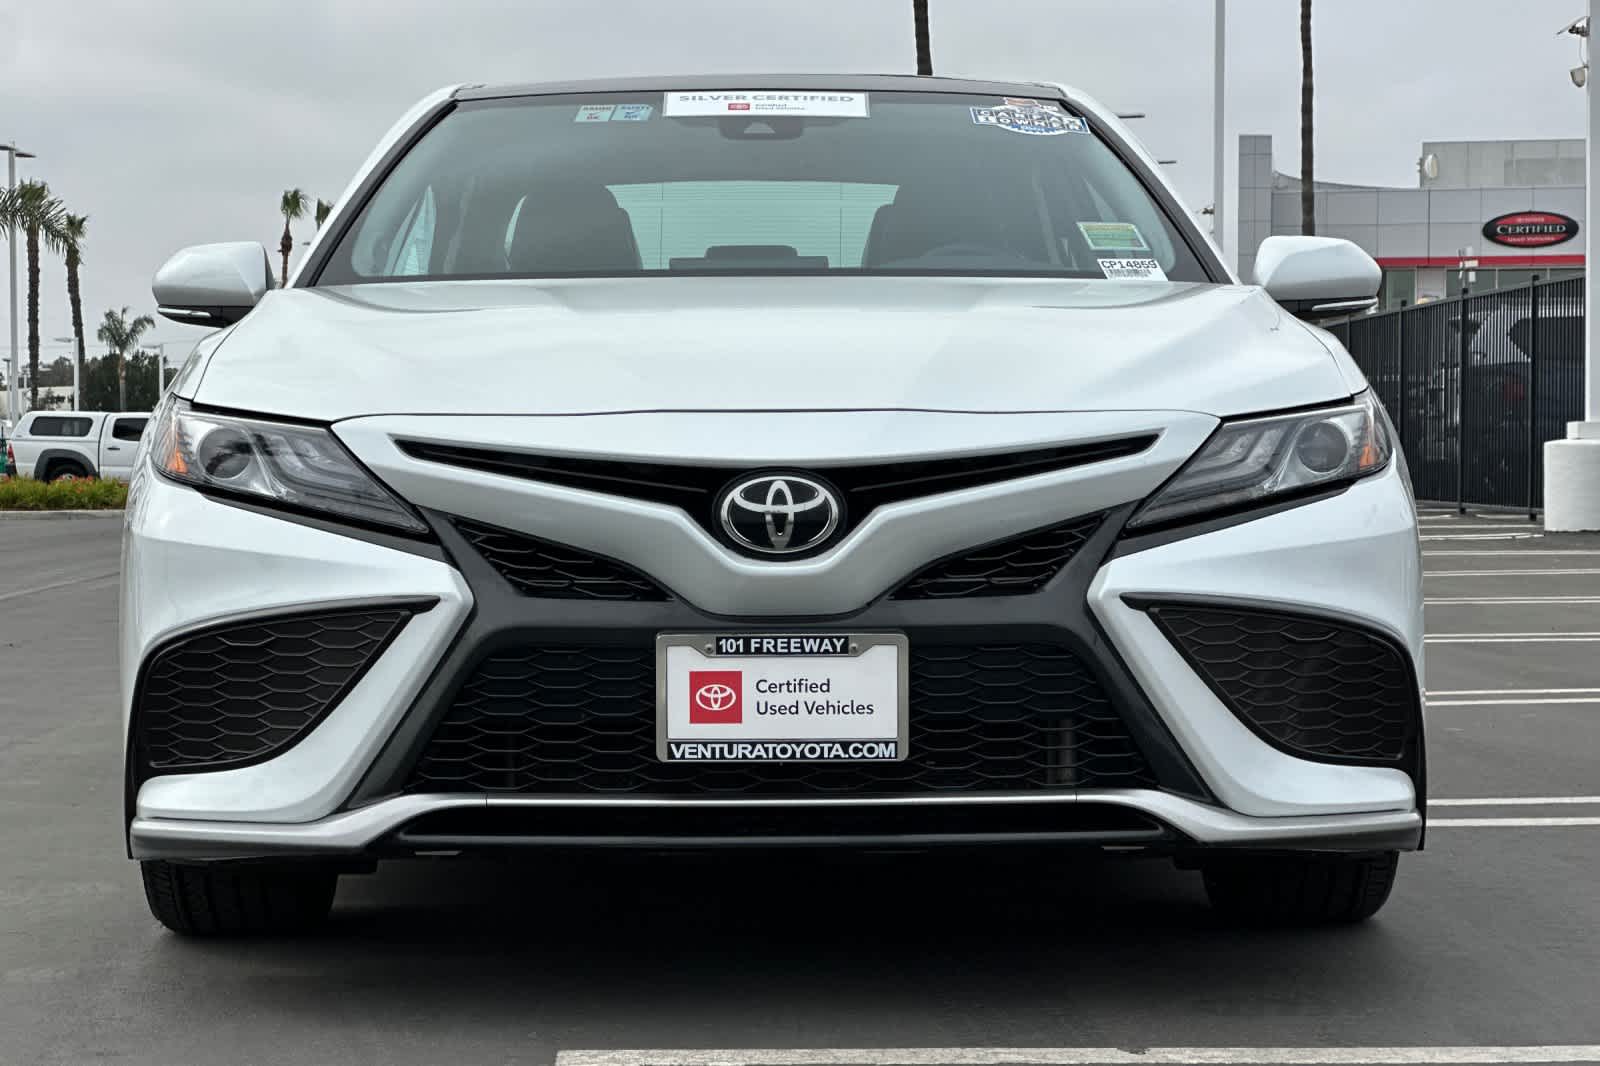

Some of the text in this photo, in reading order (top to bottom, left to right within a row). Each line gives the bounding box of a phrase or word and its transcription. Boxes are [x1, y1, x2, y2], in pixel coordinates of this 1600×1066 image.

[680, 94, 855, 103] SILVER CERTIFIED
[1496, 224, 1567, 234] CERTIFIED
[719, 638, 845, 653] 101 FREEWAY
[755, 679, 831, 693] Certified
[756, 700, 874, 715] Used Vehicles
[670, 743, 896, 759] VENTURATOYOTA.COM
